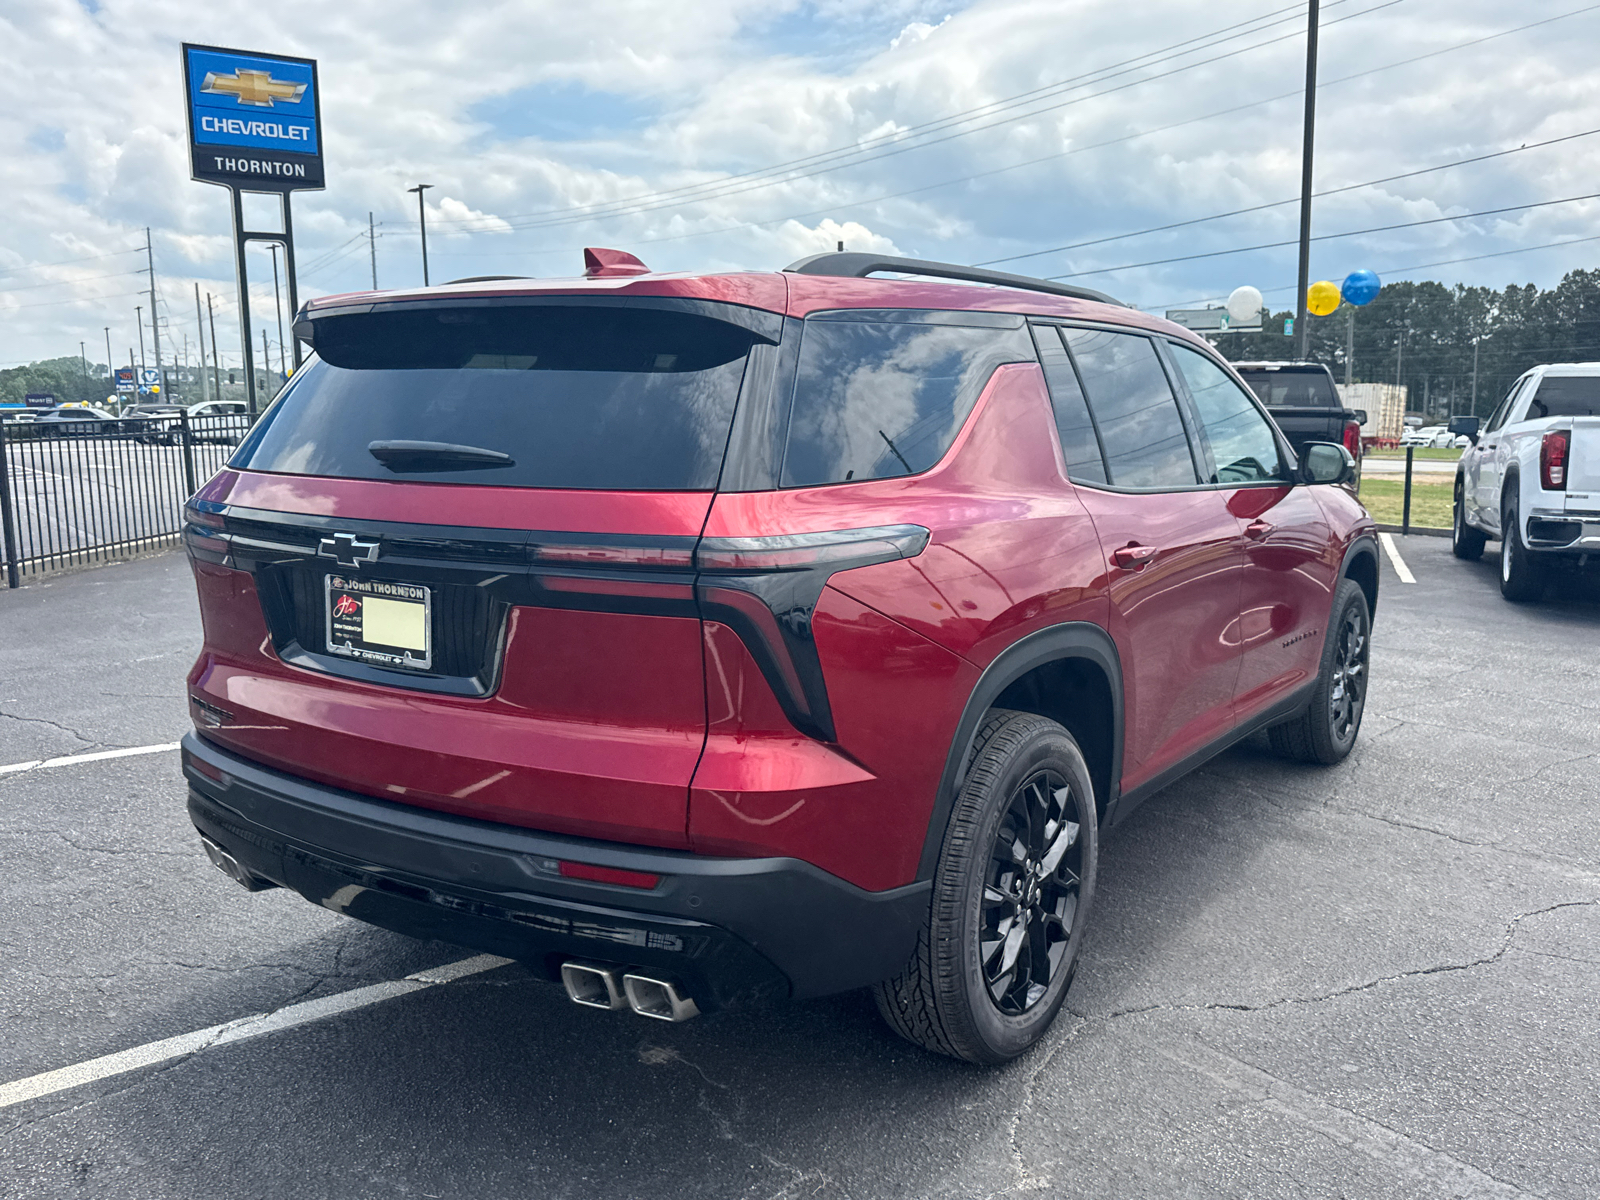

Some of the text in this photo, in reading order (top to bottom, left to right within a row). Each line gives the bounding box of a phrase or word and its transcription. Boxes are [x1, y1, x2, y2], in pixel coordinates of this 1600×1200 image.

[201, 116, 310, 141] CHEVROLET
[214, 156, 306, 177] THORNTON
[348, 579, 372, 592] JOHN
[373, 583, 424, 599] THORNTON
[362, 652, 392, 662] CHEVROLET
